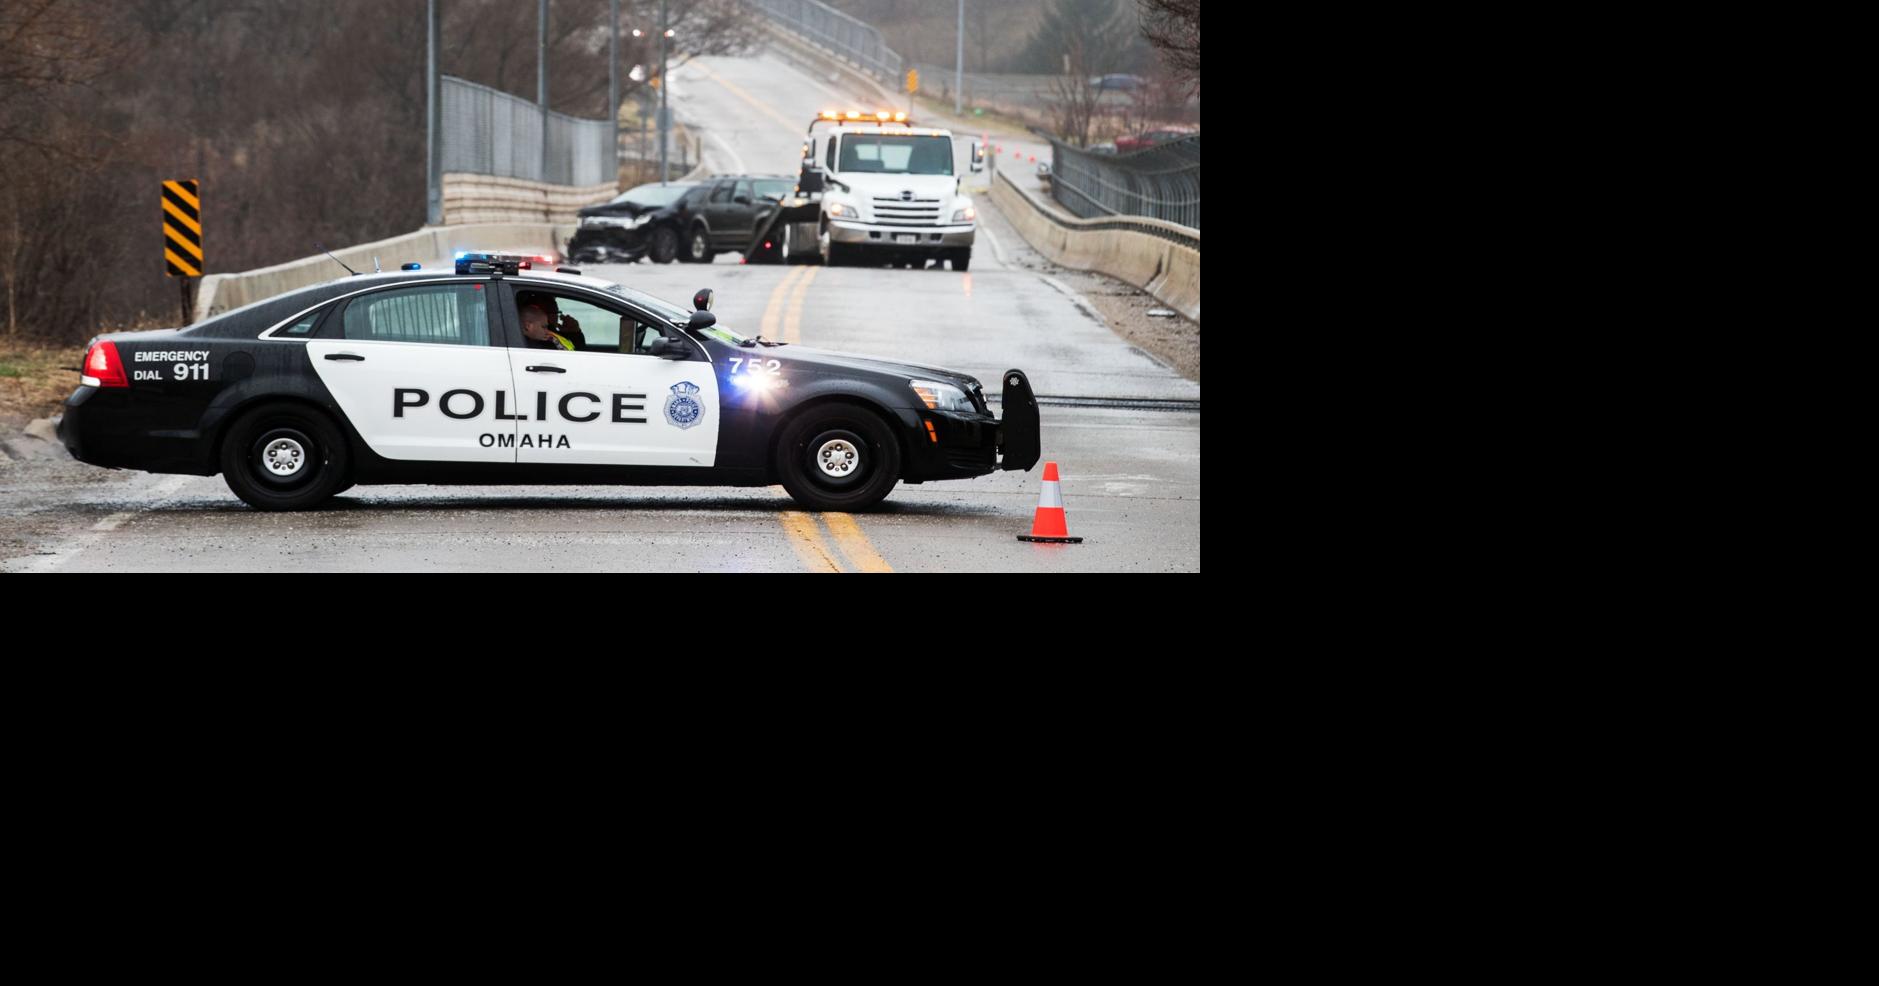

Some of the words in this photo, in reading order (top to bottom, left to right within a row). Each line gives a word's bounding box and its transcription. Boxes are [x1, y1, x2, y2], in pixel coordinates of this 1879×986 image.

[134, 350, 210, 362] EMERGENCY
[134, 370, 163, 380] DIAL
[173, 362, 209, 380] 911
[728, 357, 781, 376] 752
[393, 388, 648, 424] POLICE
[478, 433, 571, 449] OMAHA
